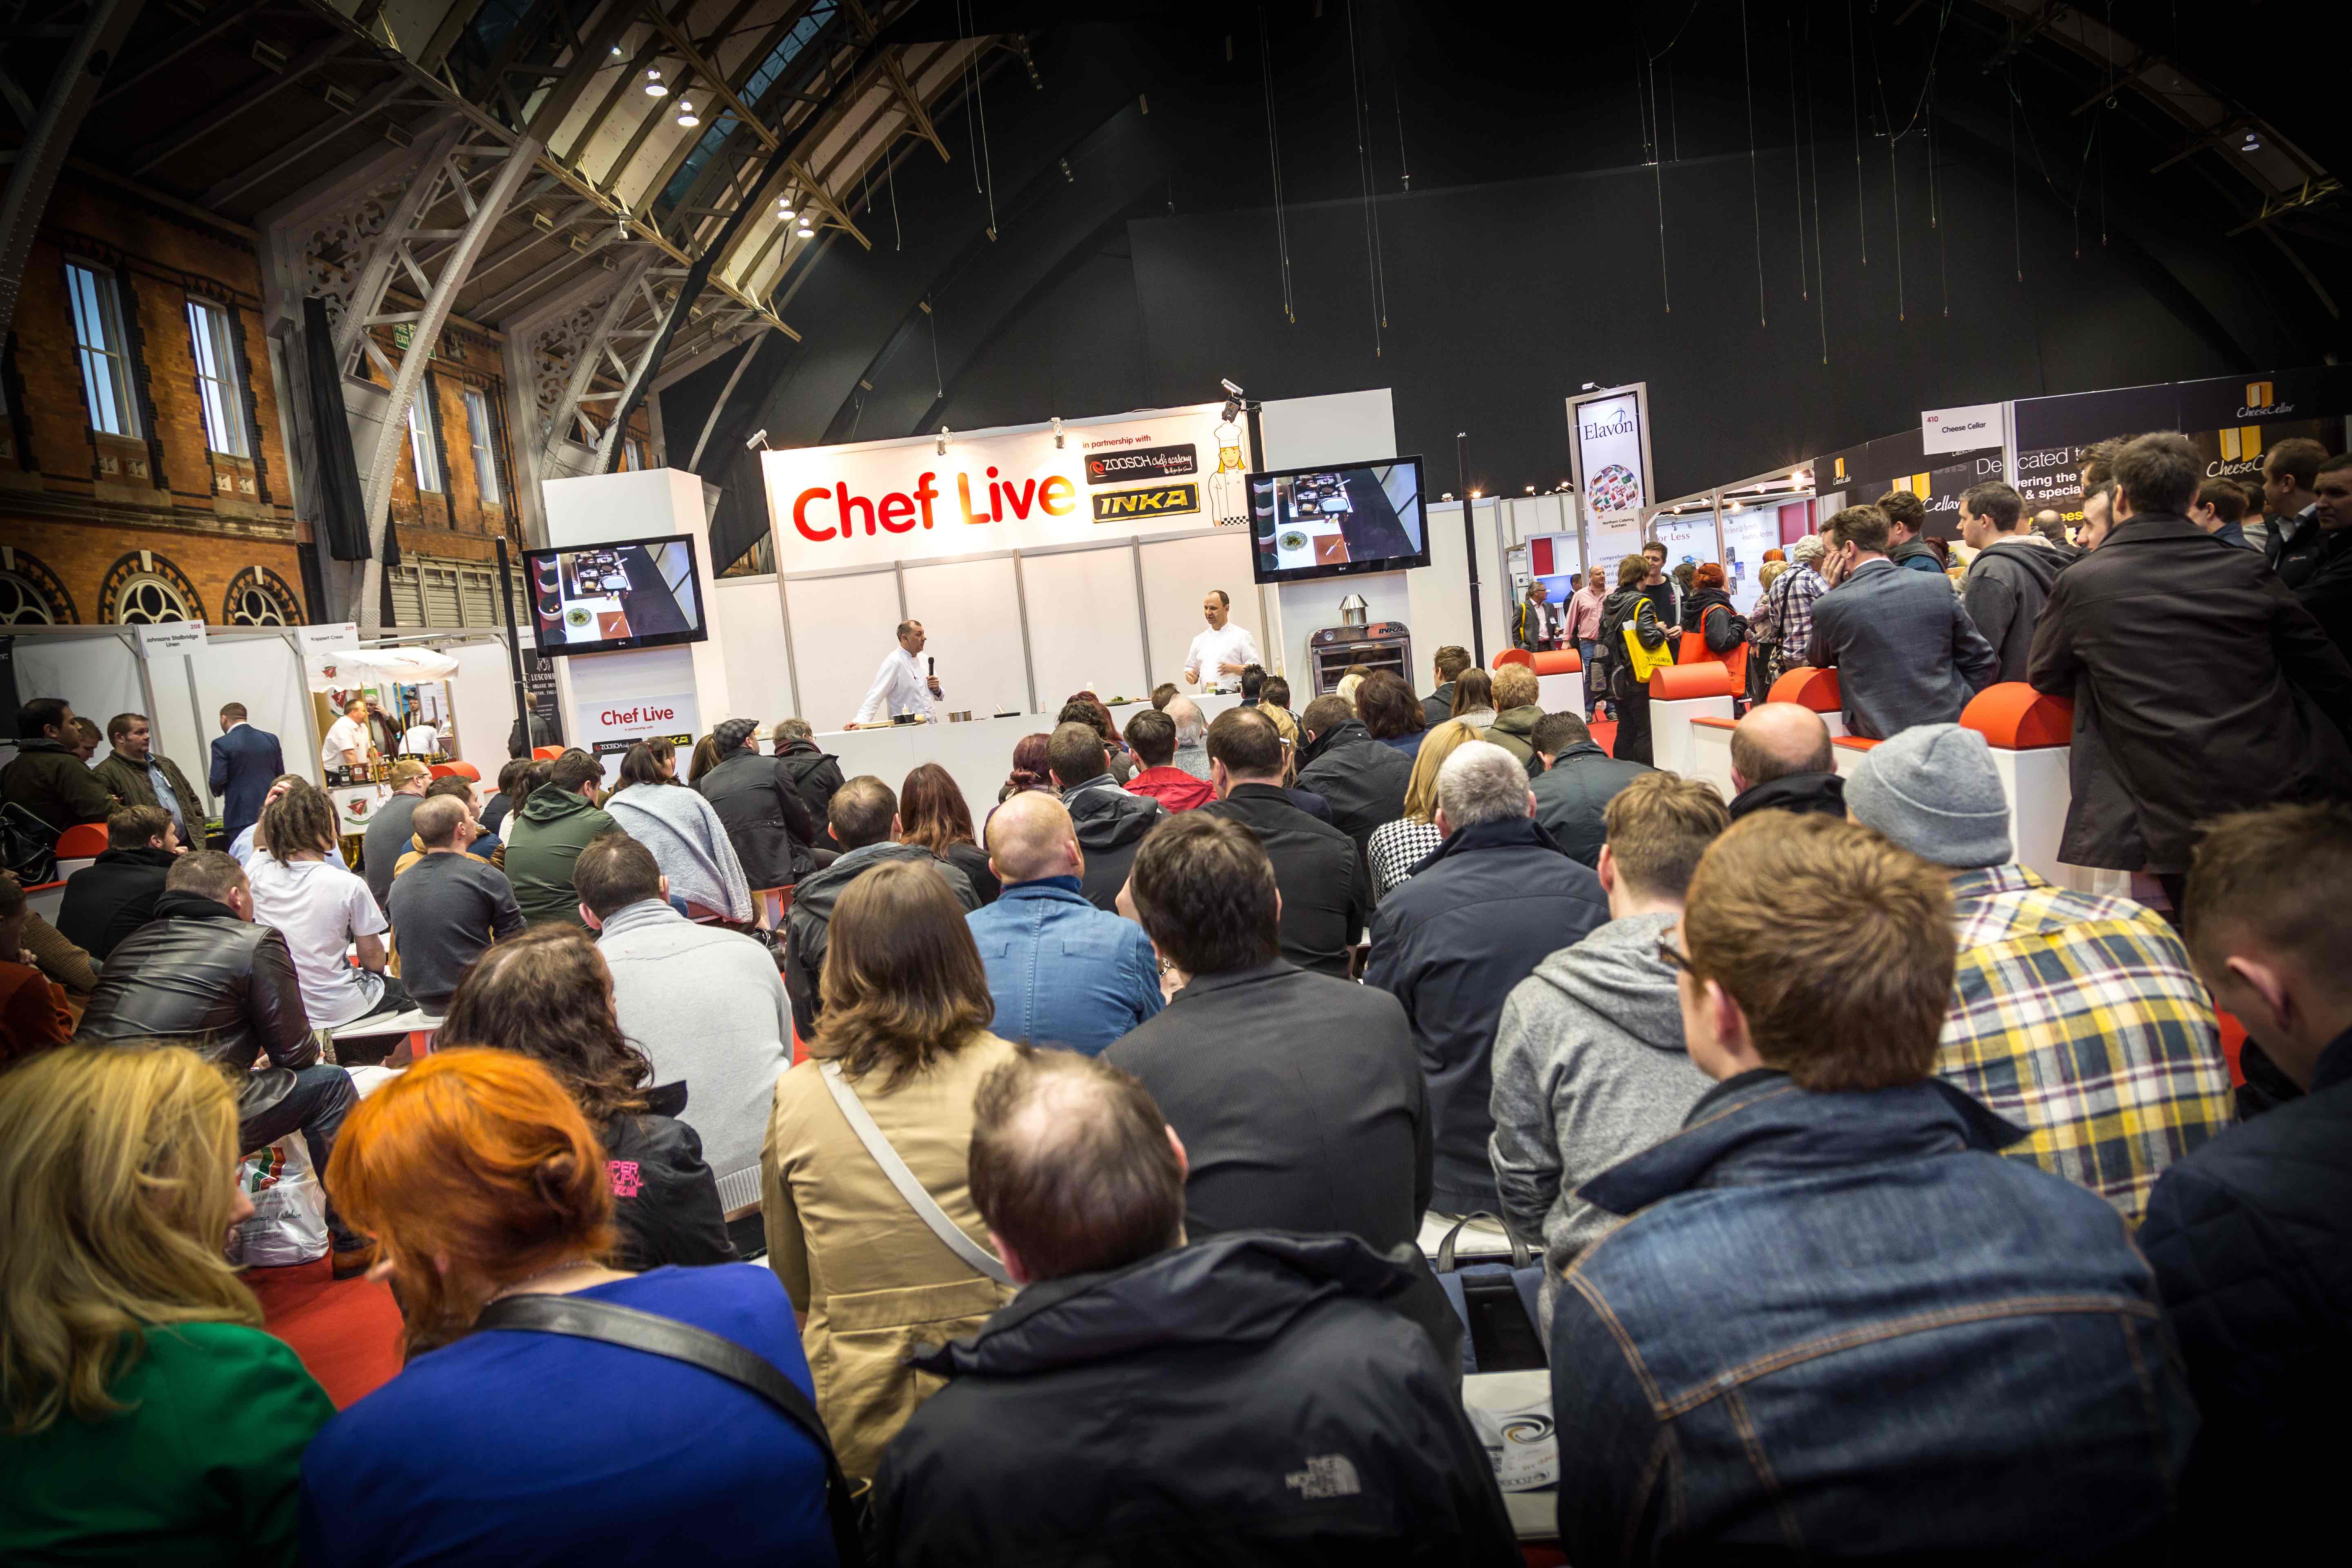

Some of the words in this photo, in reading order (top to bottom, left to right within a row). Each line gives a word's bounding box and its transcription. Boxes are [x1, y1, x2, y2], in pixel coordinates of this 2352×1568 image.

[1584, 419, 1634, 440] Elavon
[1942, 425, 1966, 433] Cheese
[1967, 421, 1986, 430] Cellar
[1091, 437, 1134, 450] partnership
[1135, 434, 1151, 443] with
[1102, 454, 1152, 471] ZOOSCH
[1168, 454, 1192, 468] academy
[2056, 472, 2077, 483] the
[1100, 490, 1188, 514] INKA
[2025, 490, 2035, 500] &
[793, 472, 939, 541] Chef
[957, 466, 1076, 525] Live
[1671, 532, 1690, 541] Less
[601, 707, 639, 726] Chef
[643, 706, 674, 722] Live
